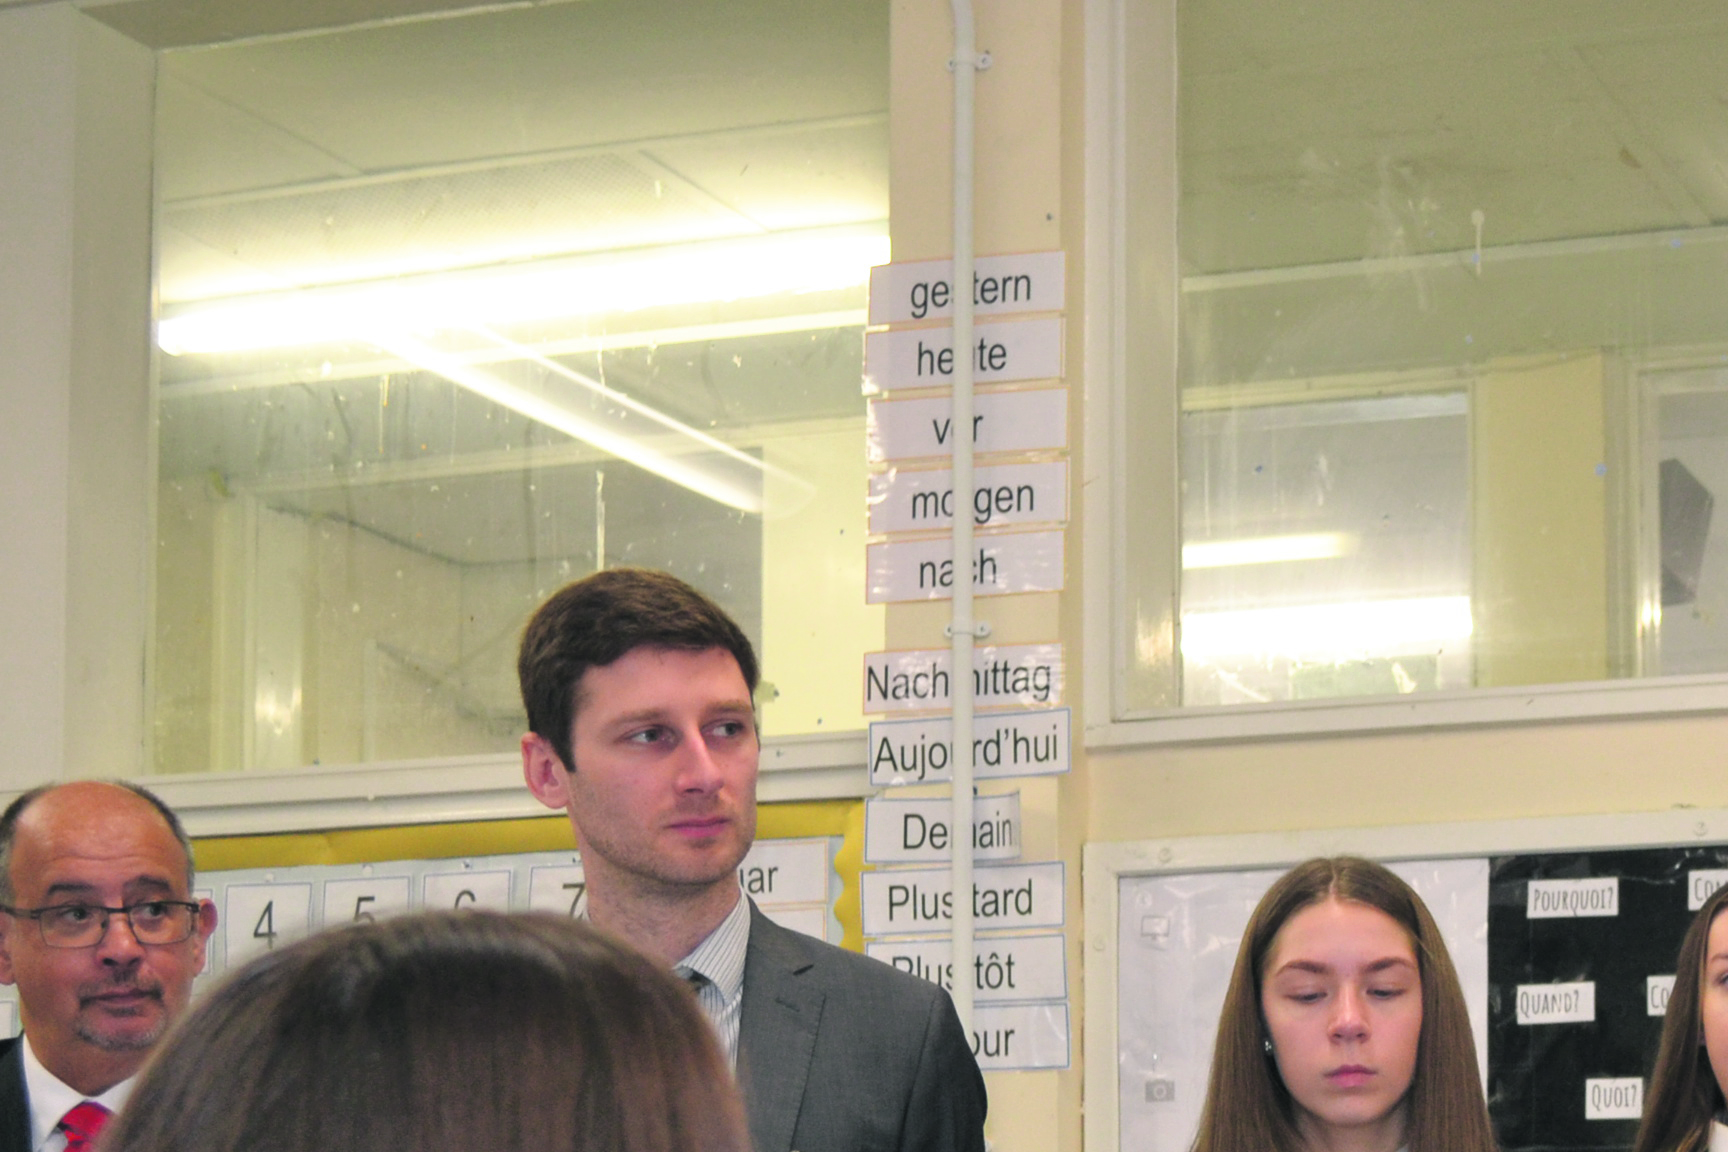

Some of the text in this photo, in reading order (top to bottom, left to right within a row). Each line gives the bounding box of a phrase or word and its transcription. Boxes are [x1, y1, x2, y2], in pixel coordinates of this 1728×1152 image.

[911, 270, 1031, 319] getern
[918, 338, 1007, 376] hete
[933, 414, 983, 445] vr
[911, 484, 1034, 524] mogen
[919, 548, 997, 588] nah
[873, 723, 1057, 781] Aujord'hui
[903, 810, 1014, 850] Deain
[562, 882, 585, 919] 7
[973, 878, 1033, 918] tard
[1533, 886, 1614, 917] POURQUOI?
[253, 900, 277, 948] 4
[974, 952, 1016, 990] tôt
[1520, 990, 1580, 1018] QUAND?
[1592, 1082, 1637, 1111] QUOI?
